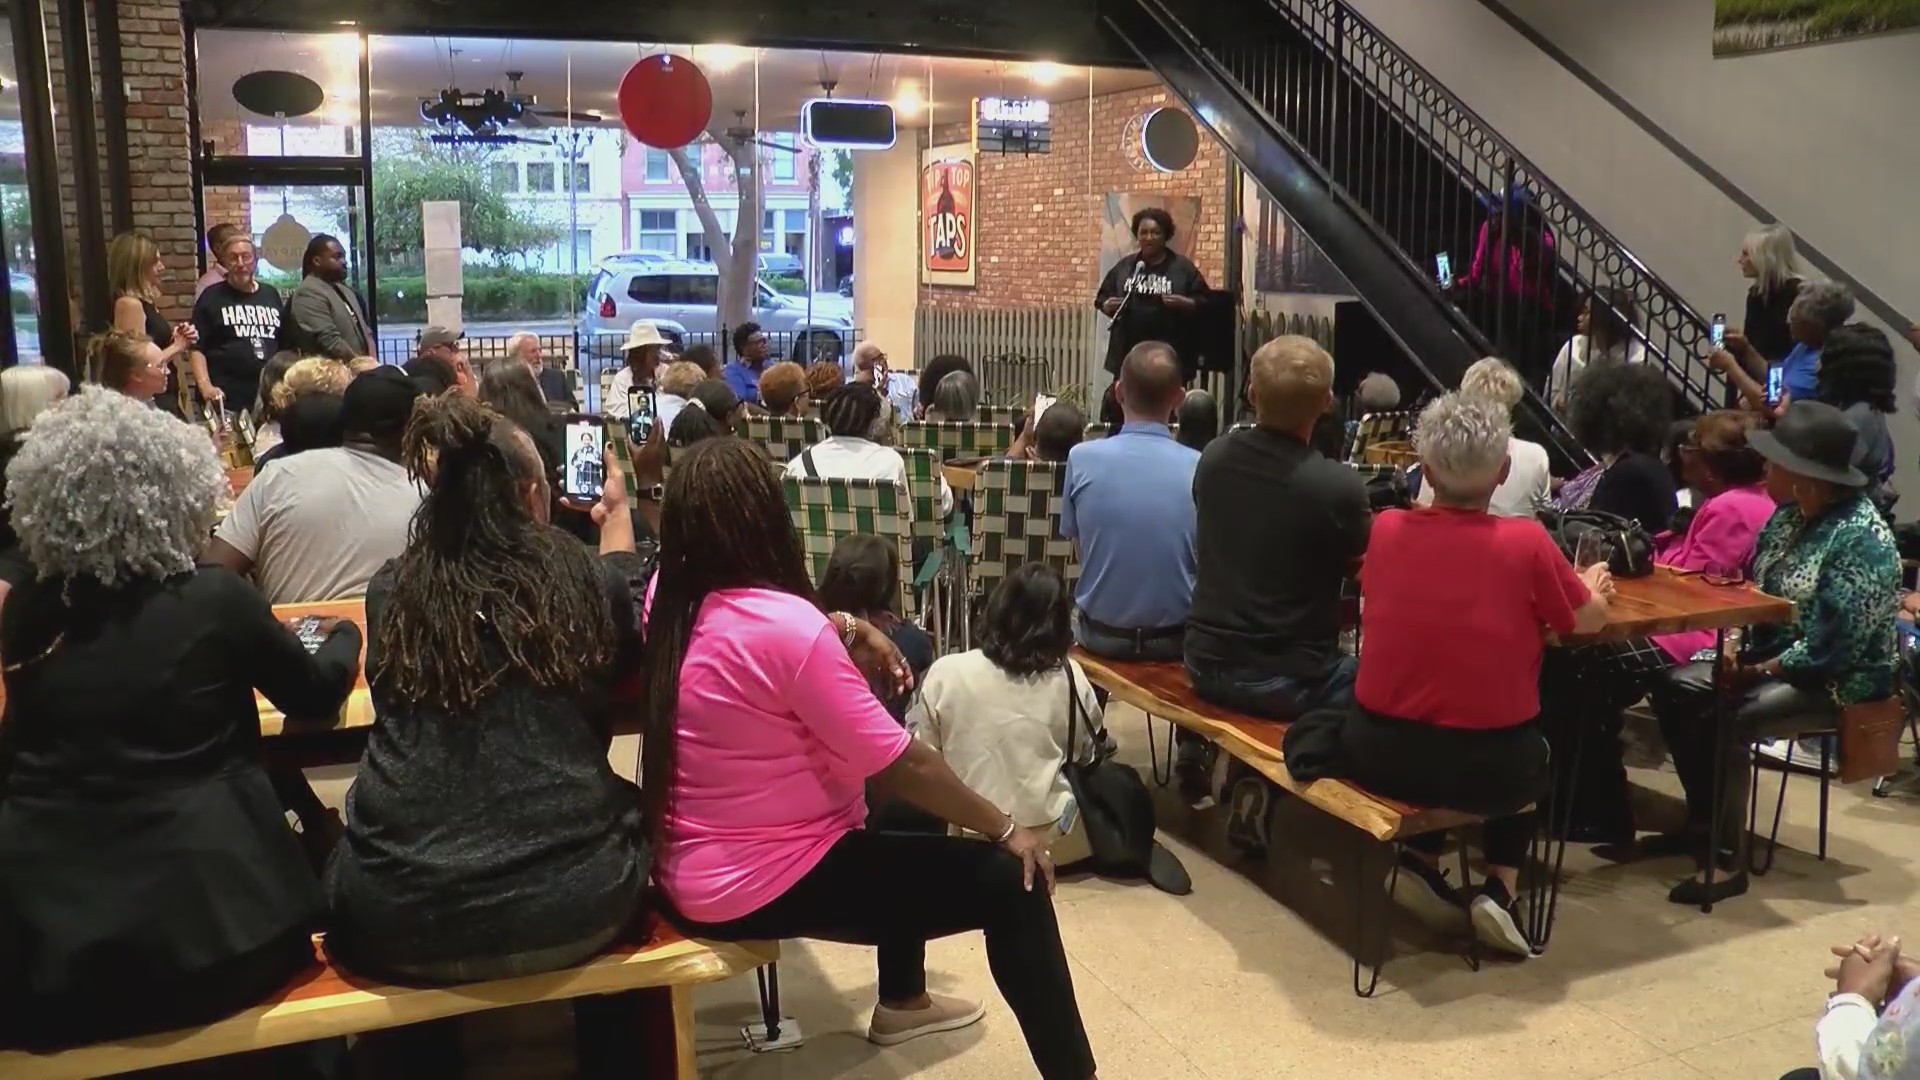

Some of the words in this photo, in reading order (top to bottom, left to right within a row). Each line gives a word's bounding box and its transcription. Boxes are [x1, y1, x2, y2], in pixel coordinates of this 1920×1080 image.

[951, 167, 970, 187] TOP
[928, 212, 966, 258] TAPS
[221, 304, 280, 327] HARRIS
[234, 325, 276, 339] WALZ
